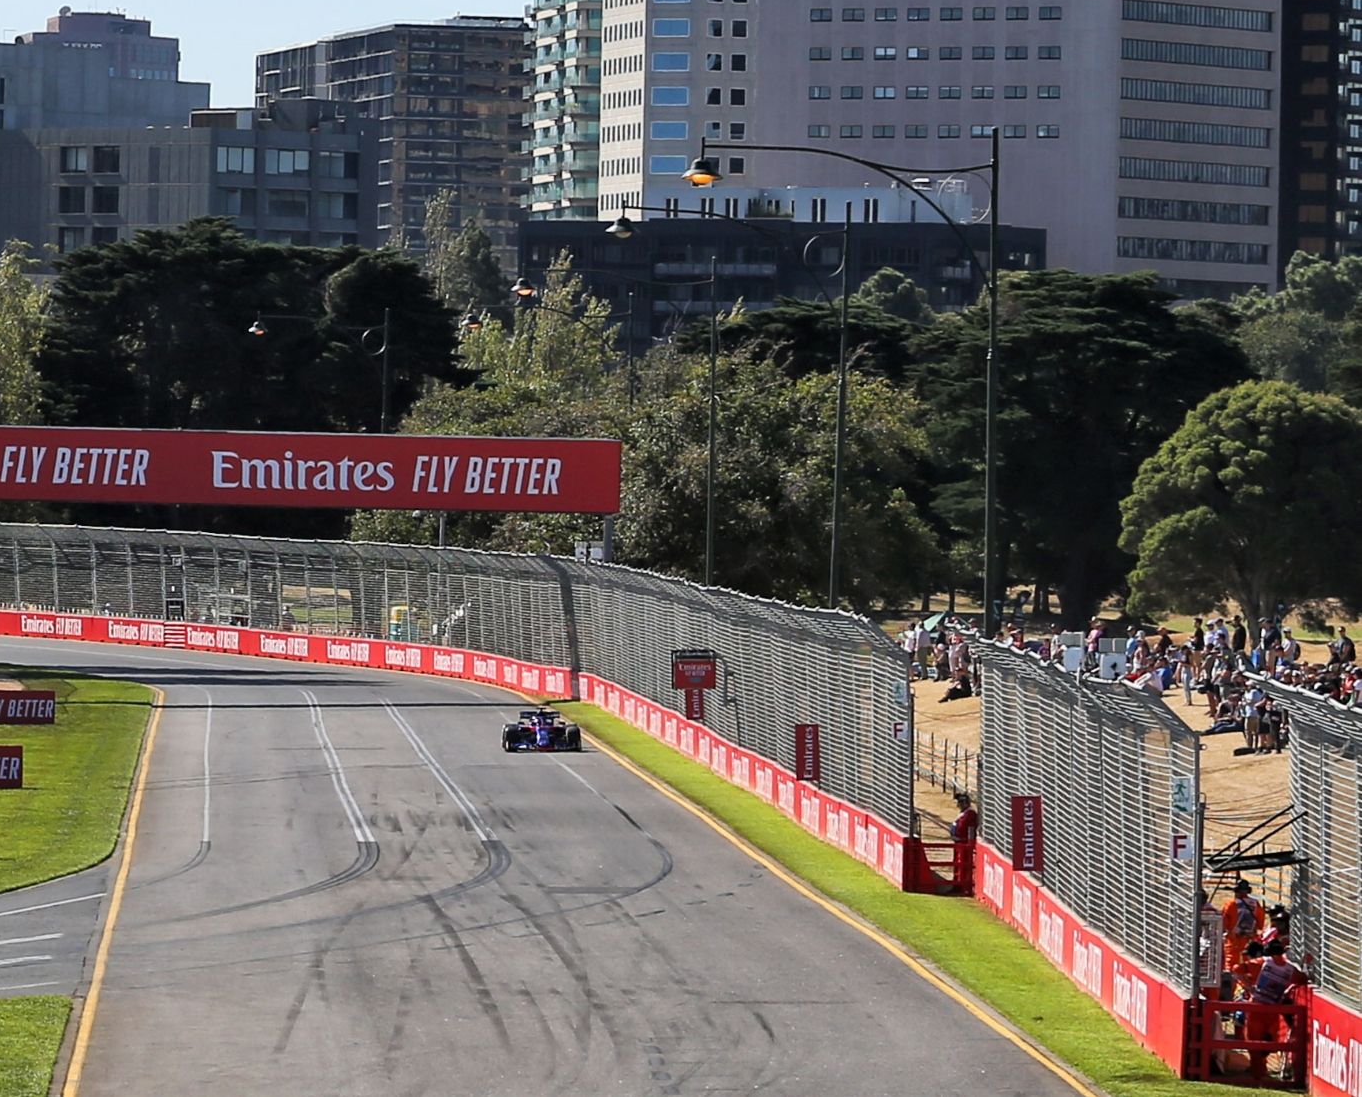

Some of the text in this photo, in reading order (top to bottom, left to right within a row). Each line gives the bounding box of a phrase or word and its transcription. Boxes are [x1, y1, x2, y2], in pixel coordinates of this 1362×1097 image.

[0, 446, 47, 483] FLY
[52, 447, 150, 486] BETTER
[211, 450, 562, 495] Emirates FLY BETTER
[21, 614, 55, 634] Emirates
[7, 699, 54, 719] BETTER
[893, 722, 905, 739] F
[803, 726, 814, 779] Emirates
[1021, 799, 1035, 869] Emirates
[1173, 835, 1187, 859] F
